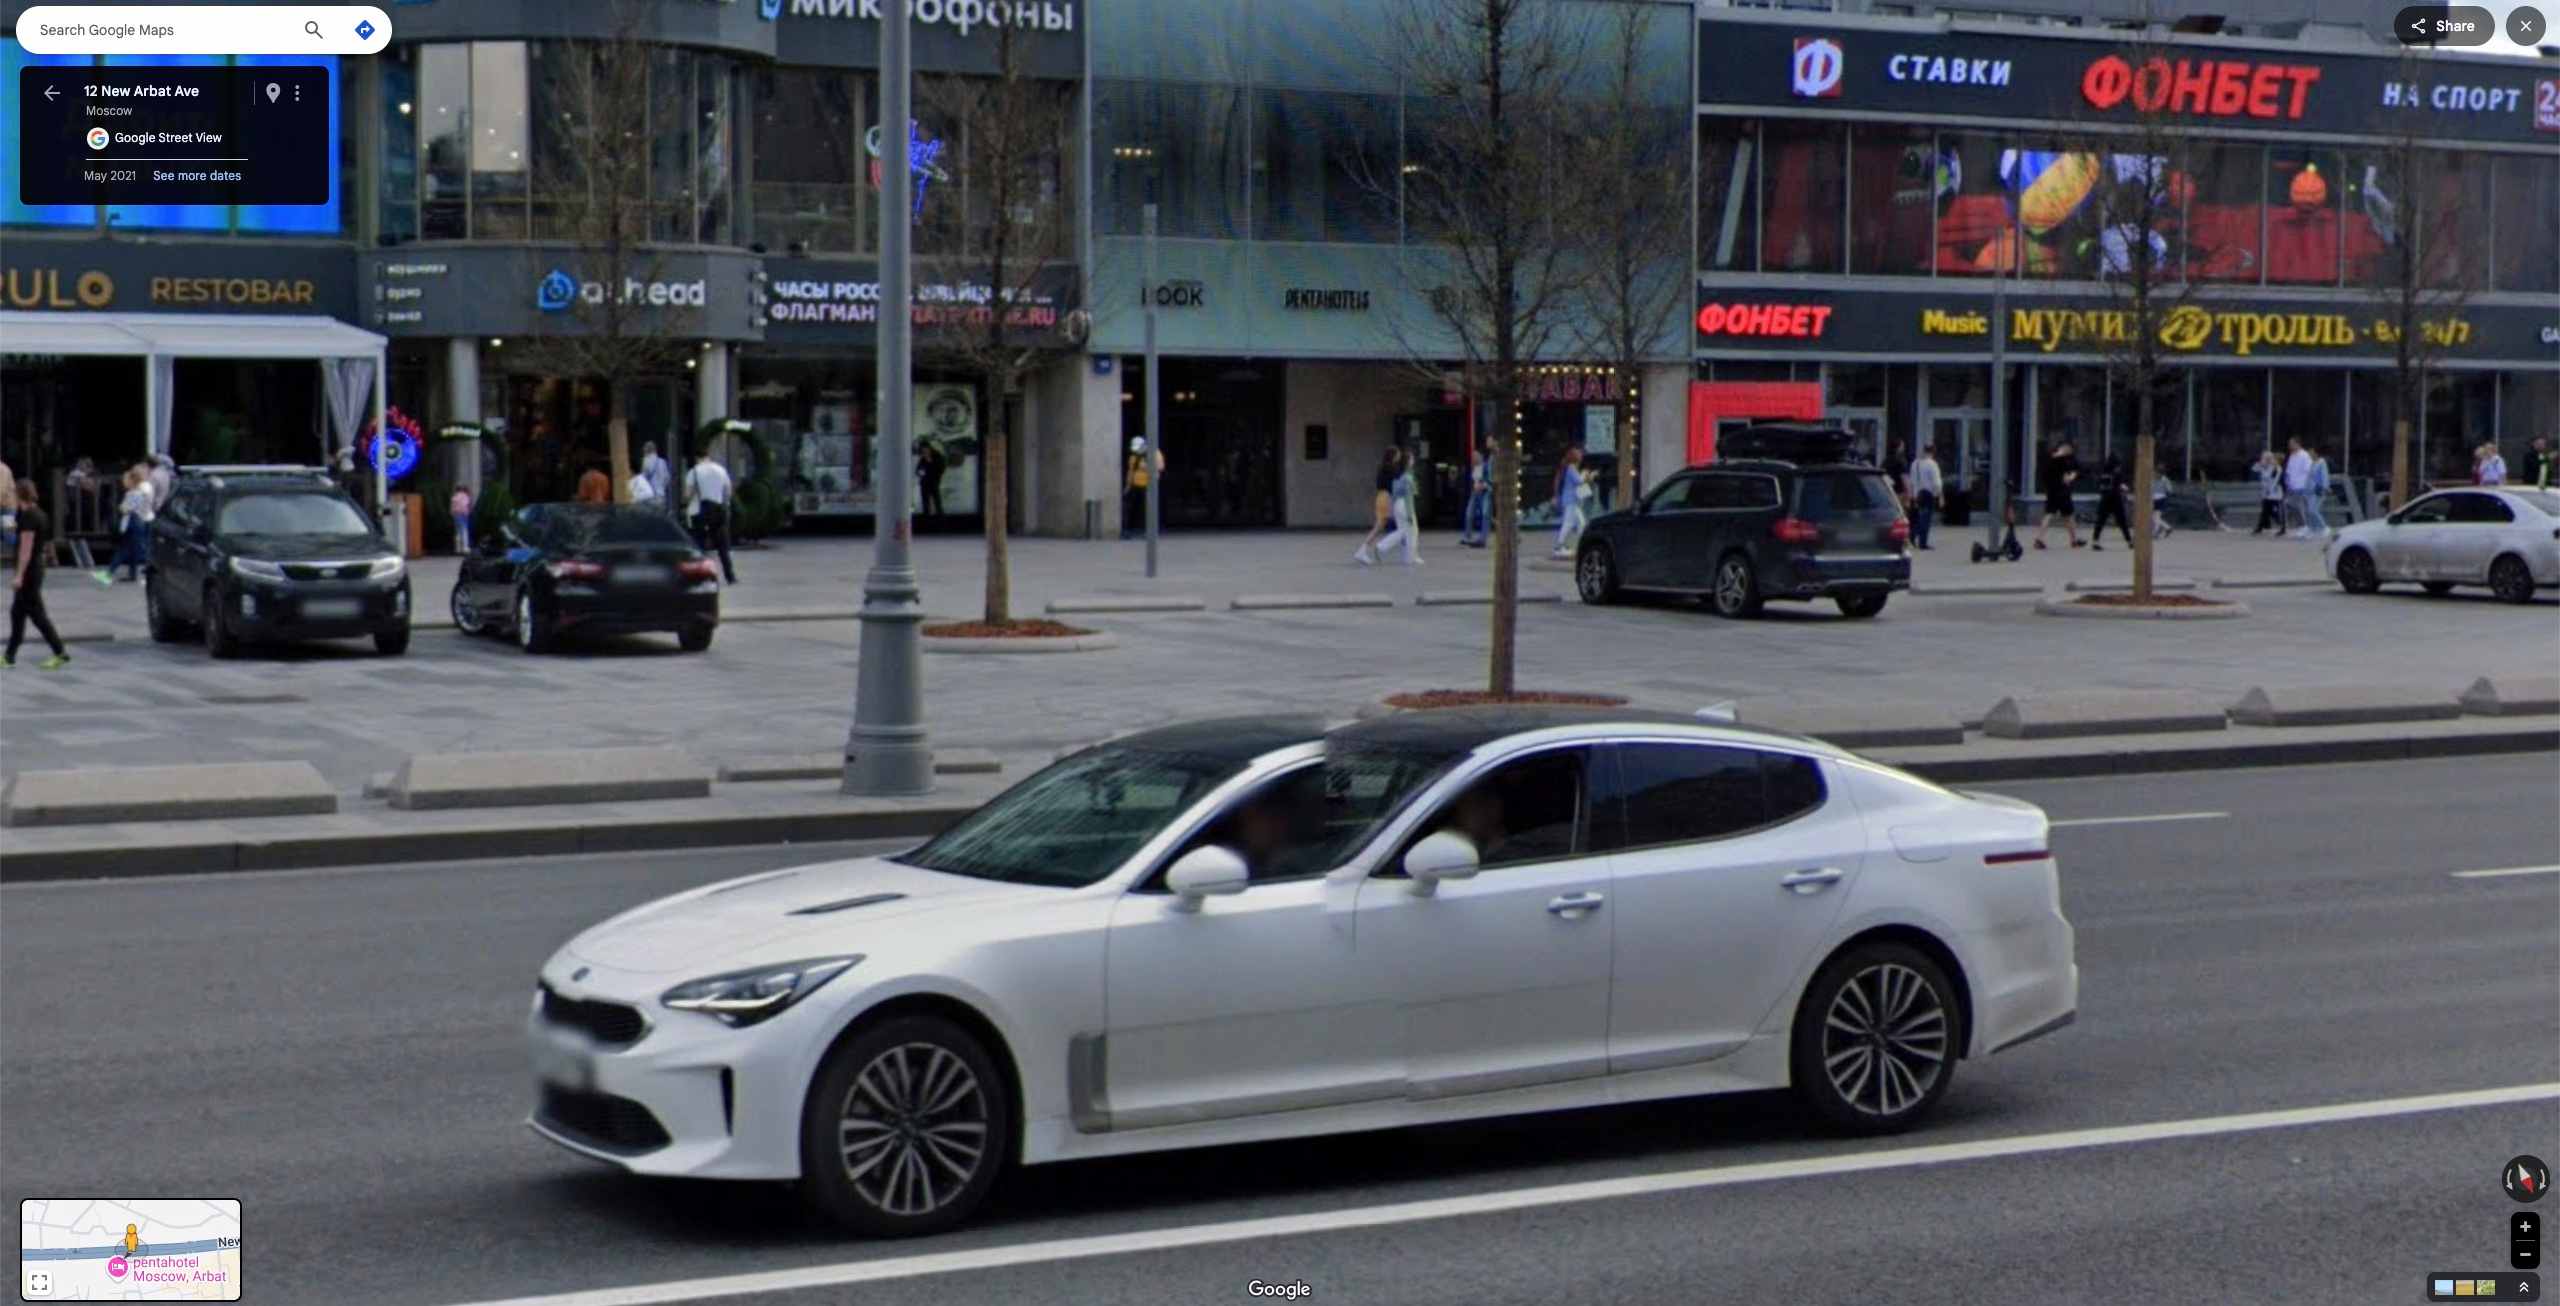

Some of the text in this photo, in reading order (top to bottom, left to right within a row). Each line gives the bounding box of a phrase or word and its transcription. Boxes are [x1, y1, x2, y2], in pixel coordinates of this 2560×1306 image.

[791, 0, 1073, 36] микофоны
[1889, 54, 2521, 119] СТАВКИ ФОНБЕТ НА СПОРТ
[0, 268, 114, 307] ULO
[152, 277, 314, 305] RESTOBAR
[774, 282, 828, 299] ЧАСЫ
[771, 303, 875, 322] ФЛАГМАН
[1697, 303, 1831, 336] ФОНБЕТ
[1922, 309, 1988, 334] Music
